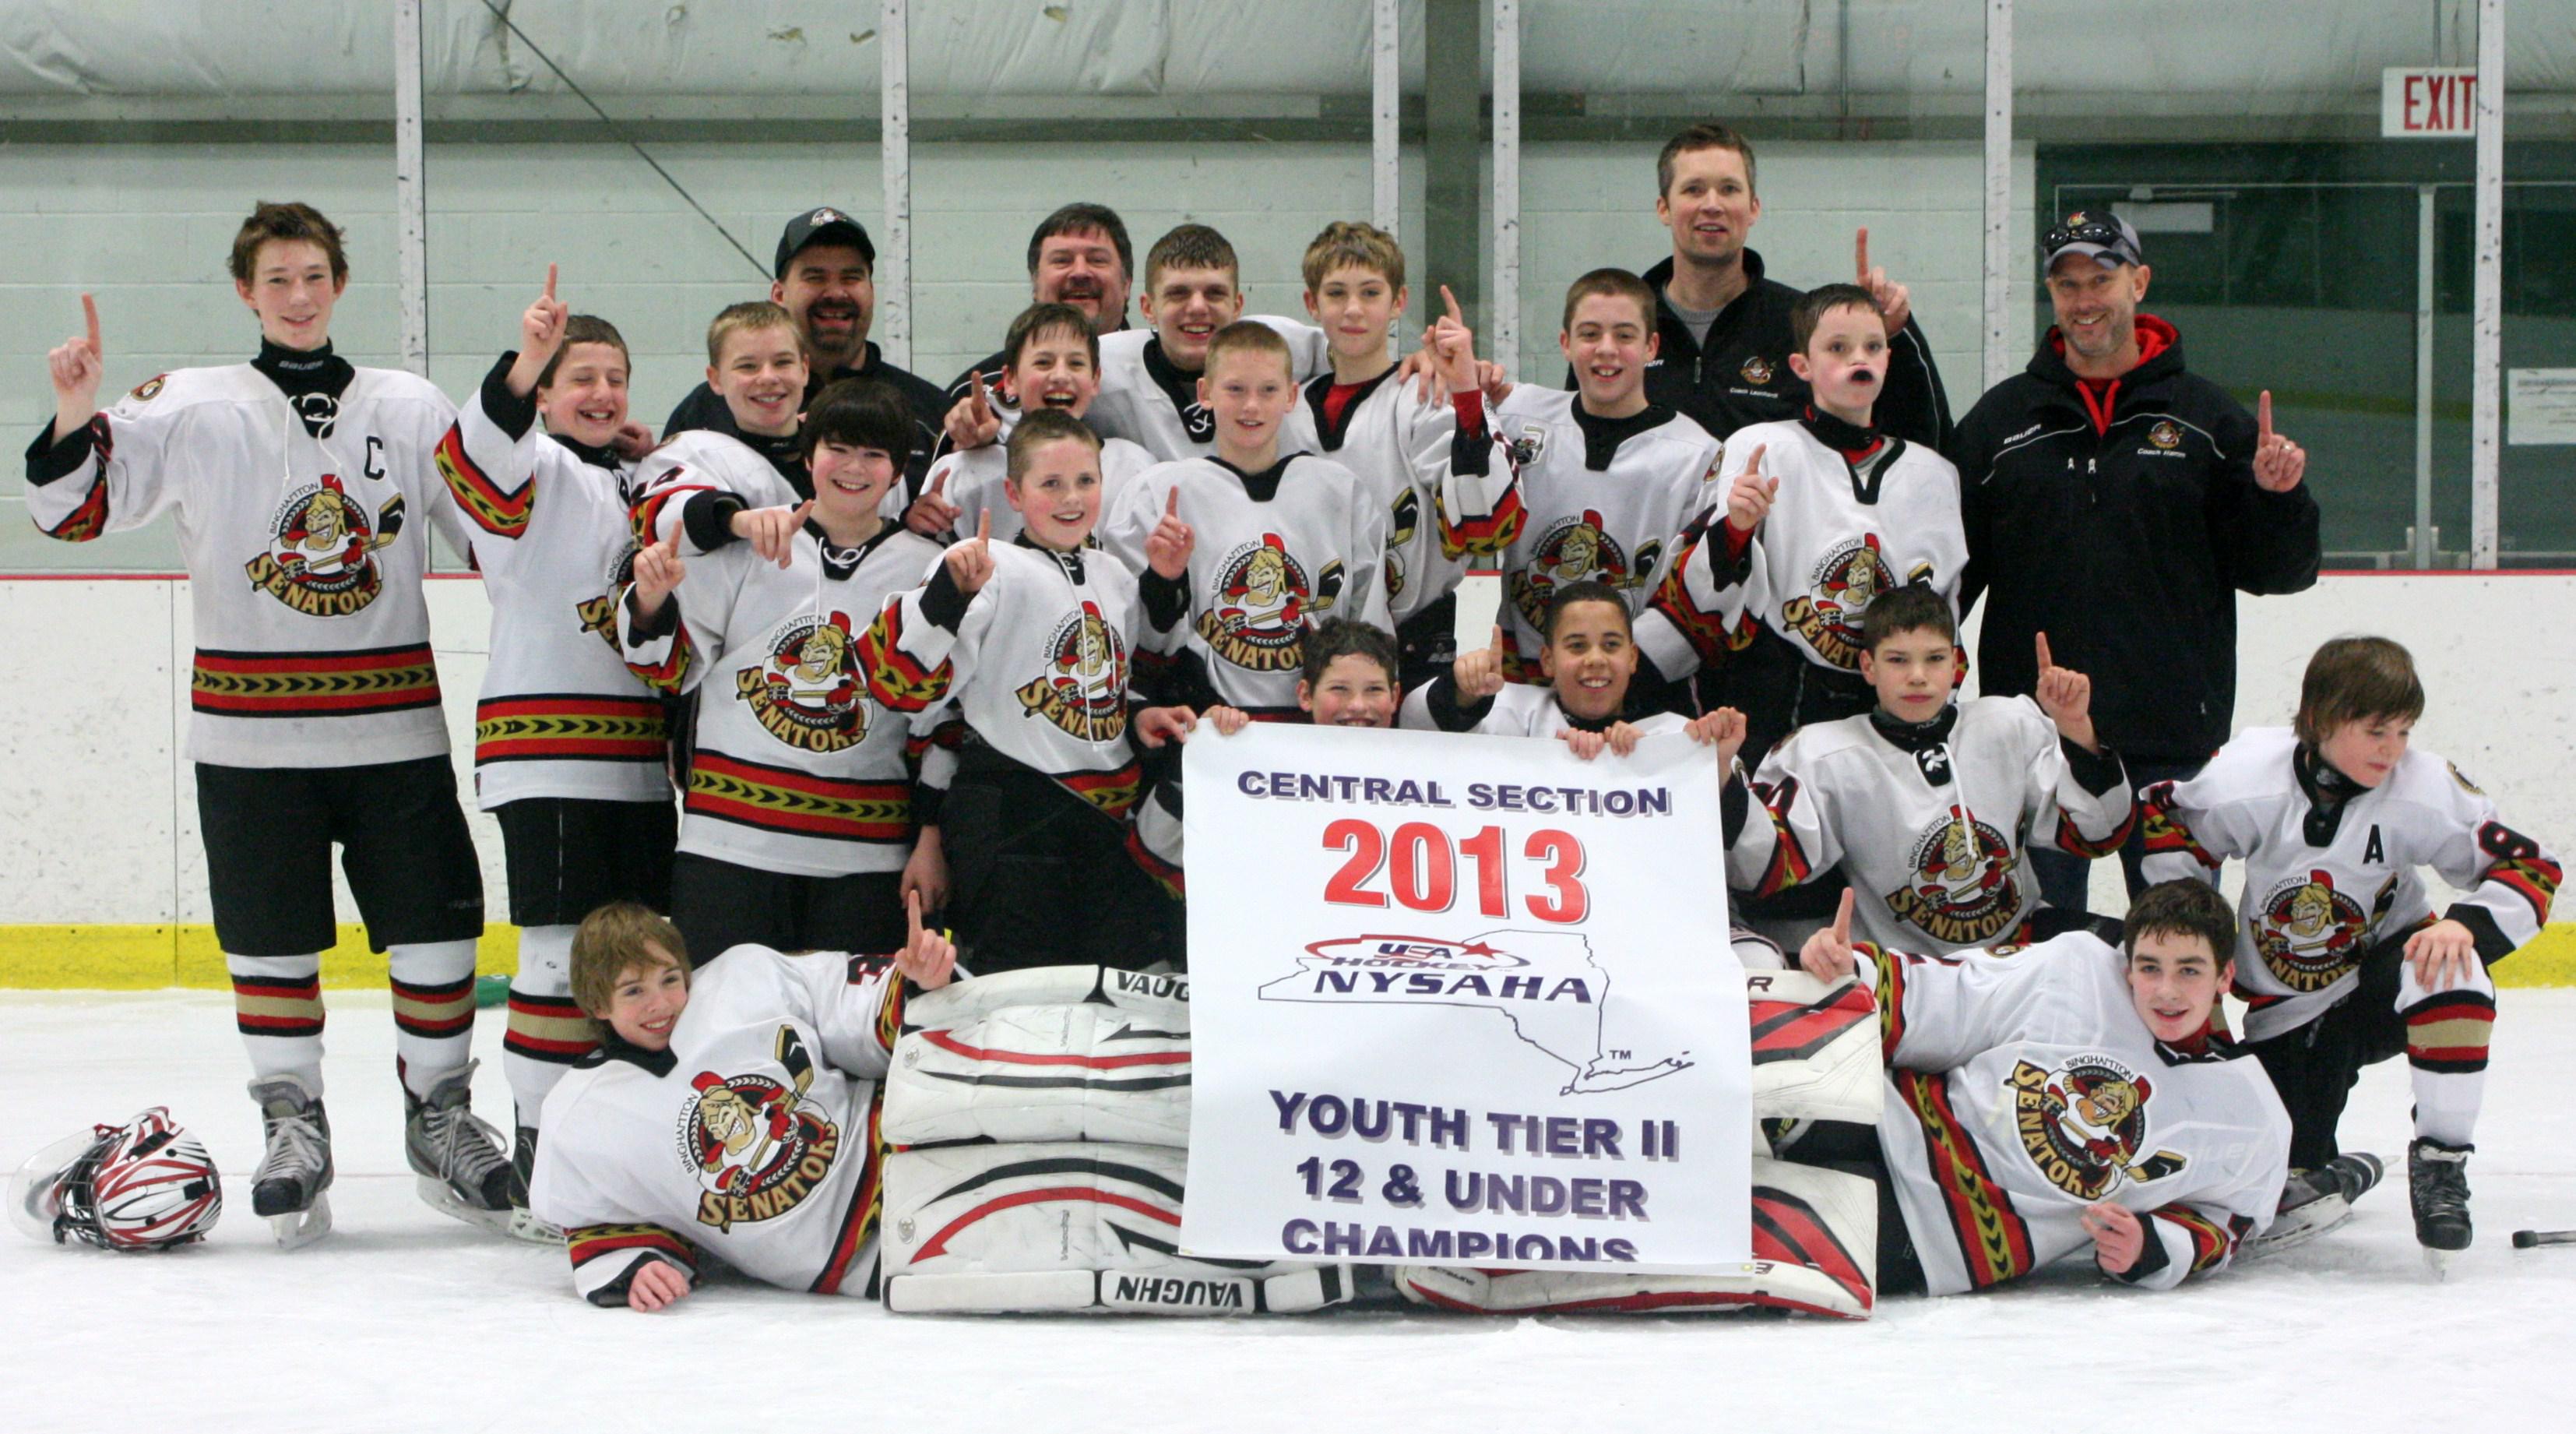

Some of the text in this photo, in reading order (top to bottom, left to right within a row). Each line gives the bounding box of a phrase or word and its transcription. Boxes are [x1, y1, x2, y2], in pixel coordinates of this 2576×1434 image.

[2404, 75, 2477, 130] EXIT
[2004, 423, 2042, 445] BAUER
[364, 435, 385, 481] C
[269, 482, 319, 534] BINGHAMTON
[1212, 540, 1261, 590] BINGHAMTON
[1811, 538, 1863, 581] BINGHAMTON
[1196, 608, 1304, 671] SENATO
[1782, 595, 1860, 669] SENAT
[1237, 770, 1672, 816] CENTRAL SECTION
[1909, 814, 1951, 869] BINGHAMTON
[2362, 823, 2384, 865] A
[1321, 818, 1589, 925] 2013
[1331, 957, 1498, 971] HOCKEY
[1374, 942, 1453, 960] USA
[1117, 971, 1189, 1002] VAUG
[1313, 970, 1592, 1004] NYSAHA
[1609, 1049, 1632, 1060] TM
[2064, 1054, 2134, 1081] BINGHAMTON
[675, 1093, 699, 1175] BINGHAMTON
[1268, 1090, 1680, 1161] YOUTH TIER II
[2012, 1059, 2103, 1200] SENATORS
[696, 1122, 839, 1227] SENATORS
[1296, 1155, 1650, 1221] 12 & UNDER
[1281, 1218, 1639, 1263] CHAMPIONS
[1114, 1275, 1244, 1308] VAUGHN
